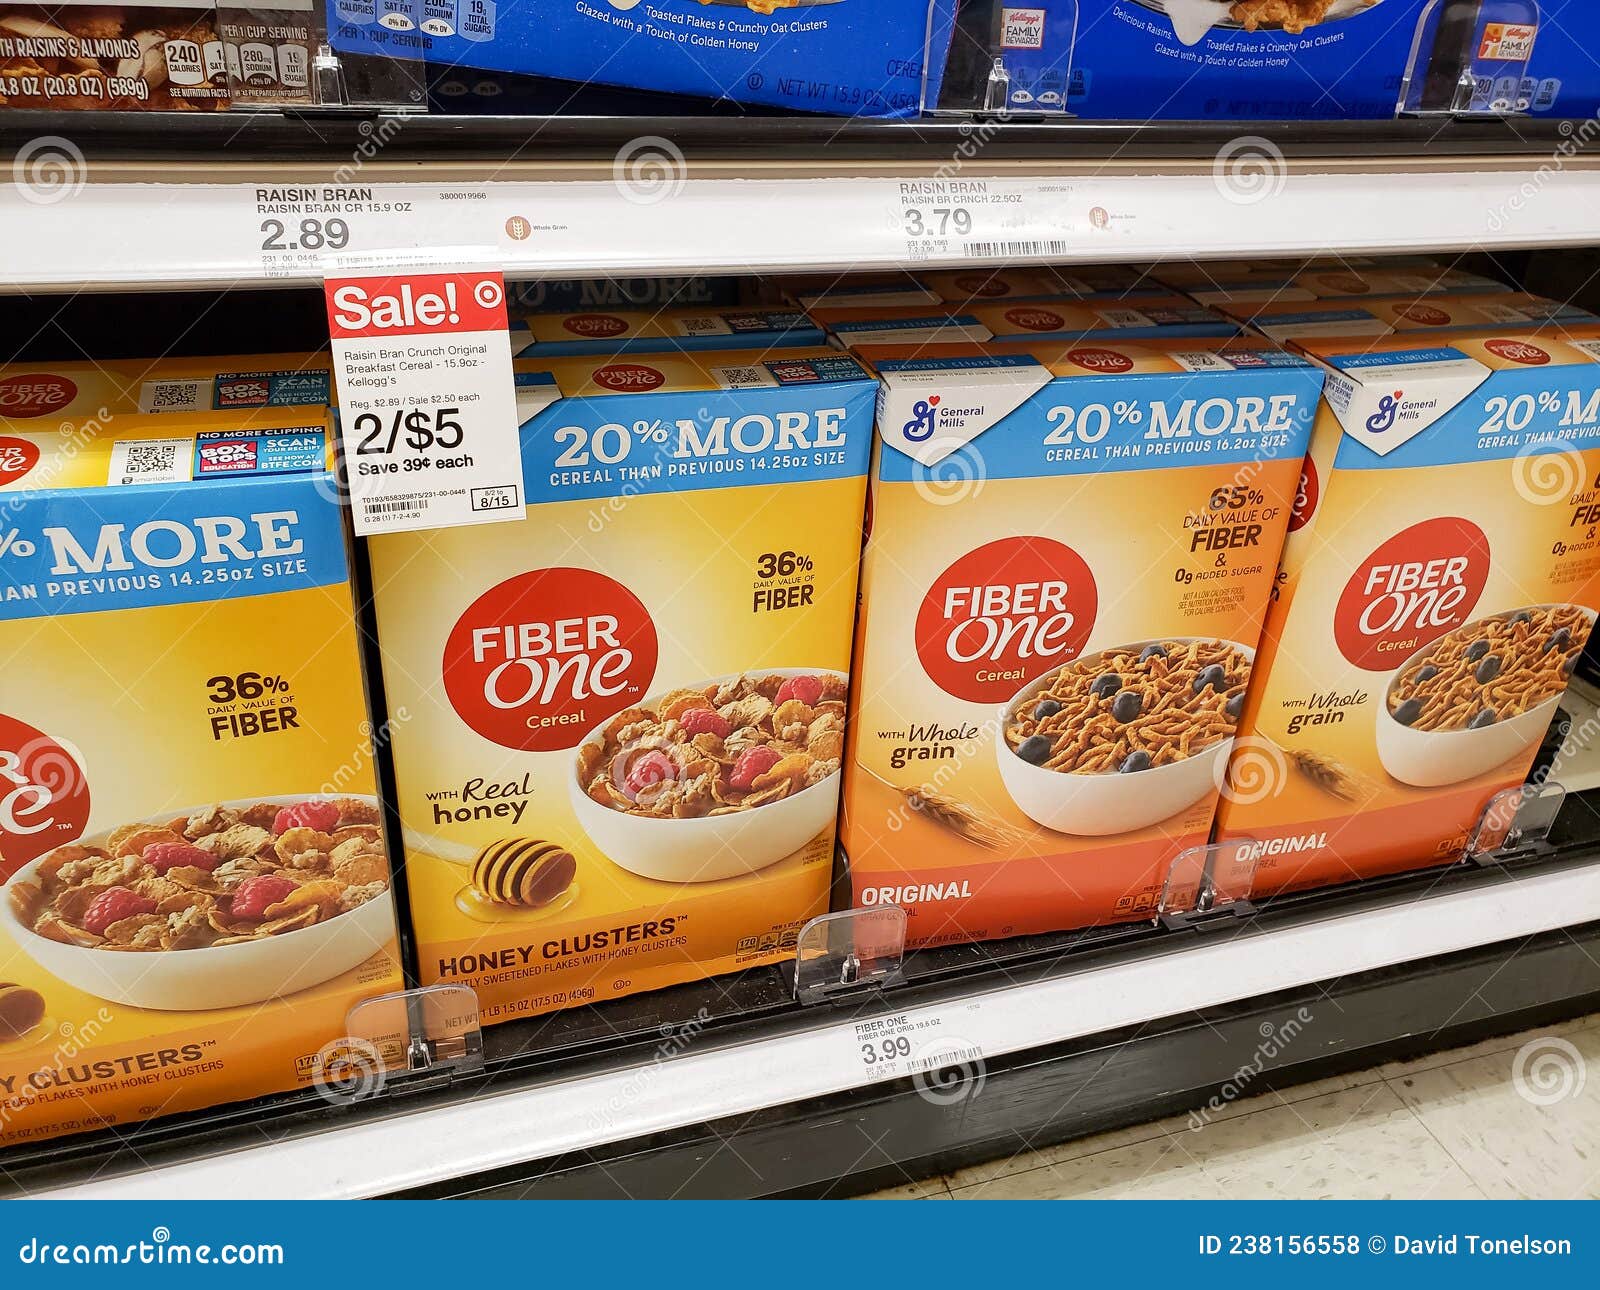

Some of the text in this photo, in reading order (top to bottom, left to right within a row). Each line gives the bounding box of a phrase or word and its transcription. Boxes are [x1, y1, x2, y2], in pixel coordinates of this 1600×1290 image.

[424, 7, 453, 20] SODIUM
[645, 5, 828, 36] Toasted Flakes Crunchy Oat Clusters
[1112, 6, 1146, 30] Delicious
[269, 27, 308, 40] SERVING
[463, 23, 491, 34] SUGARS
[575, 1, 760, 52] Glazed with Touch Golden Honey
[1006, 26, 1040, 37] FAMILY
[16, 38, 140, 58] RAISINS ALMONDS
[392, 33, 433, 50] SERVING
[1206, 32, 1344, 55] Toasted Flakes Crunchy Clusters
[167, 45, 198, 63] 240
[1154, 42, 1290, 69] Glazed Touch Golden Honey
[169, 64, 201, 73] CALORIES
[22, 77, 149, 100] OZ (20.8 OZ) (589g)
[256, 188, 372, 202] RAISIN BRAN
[439, 192, 487, 200] 3800019966
[900, 182, 987, 194] RAISIN BRAN
[257, 203, 391, 214] RAISIN BRAN CR 15.9
[901, 196, 935, 205] RAISIN
[904, 208, 972, 236] 3.79
[260, 218, 350, 251] 2.89
[333, 282, 460, 330] Sale!
[344, 344, 487, 360] Raisin Bran Crunch Original
[346, 358, 478, 374] Breakfast Cereal 15.9oz
[600, 369, 652, 379] FIBER
[348, 376, 397, 388] Kellogg's
[350, 394, 456, 409] Reg. $2.89 Sale $2.50
[940, 405, 984, 417] General
[1401, 398, 1437, 410] General
[1477, 390, 1561, 434] 20%
[939, 418, 965, 428] Mills
[1043, 399, 1143, 447] 20%
[1144, 394, 1297, 439] MORE
[1398, 411, 1420, 420] Mills
[264, 426, 323, 436] CLIPPING
[354, 408, 464, 455] 2/$5
[553, 407, 848, 468] 20% MORE
[1477, 434, 1520, 449] CEREAL
[1524, 431, 1553, 444] THAN
[200, 443, 249, 458] BOX
[266, 438, 317, 448] SCAN
[1046, 434, 1288, 462] CEREAL THAN PREVIOUS SIZE
[207, 451, 257, 464] TOPS
[261, 459, 323, 469] BTFE.COM
[358, 454, 474, 476] Save 39¢ each
[549, 451, 847, 487] CEREAL THAN PREVIOUS SIZE
[480, 496, 510, 508] 8/15
[1209, 486, 1264, 511] 65%
[1569, 491, 1598, 506] DAILY
[1183, 507, 1280, 529] DAILY VALUE OF
[44, 510, 305, 576] MORE
[1190, 524, 1263, 553] FIBER
[757, 551, 813, 579] 36%
[1195, 565, 1263, 581] ADDED SUGAR
[50, 574, 162, 599] PREVIOUS
[262, 558, 308, 577] SIZE
[753, 576, 801, 589] DAILY VALUE
[1363, 556, 1469, 596] FIBER
[753, 584, 814, 613] FIBER
[943, 580, 1068, 619] FIBER
[472, 613, 620, 663] FIBER
[1376, 636, 1418, 653] Cereal
[975, 666, 1026, 683] Cereal
[206, 672, 289, 703] 36%
[207, 698, 276, 715] DAILY VALUE
[1308, 688, 1369, 710] Whole
[211, 706, 300, 741] FIBER
[525, 709, 586, 730] Cereal
[1287, 709, 1344, 735] grain
[908, 722, 979, 742] Whole
[890, 742, 955, 769] grain
[425, 772, 535, 802] WITH Real
[433, 799, 528, 825] honey
[1235, 832, 1328, 862] ORIGINAL
[861, 880, 972, 906] ORIGINAL
[439, 944, 535, 977] HONEY
[483, 935, 687, 986] SWEETENED FLAKES WITH HONEY CLUSTERS
[855, 1015, 908, 1034] FIBER ONE
[857, 1030, 879, 1042] FIBER
[861, 1036, 911, 1065] 3.99
[38, 1088, 85, 1104] FLAKES
[86, 1081, 119, 1095] WITH
[121, 1073, 161, 1089] HONEY
[164, 1060, 224, 1081] CLUSTERS
